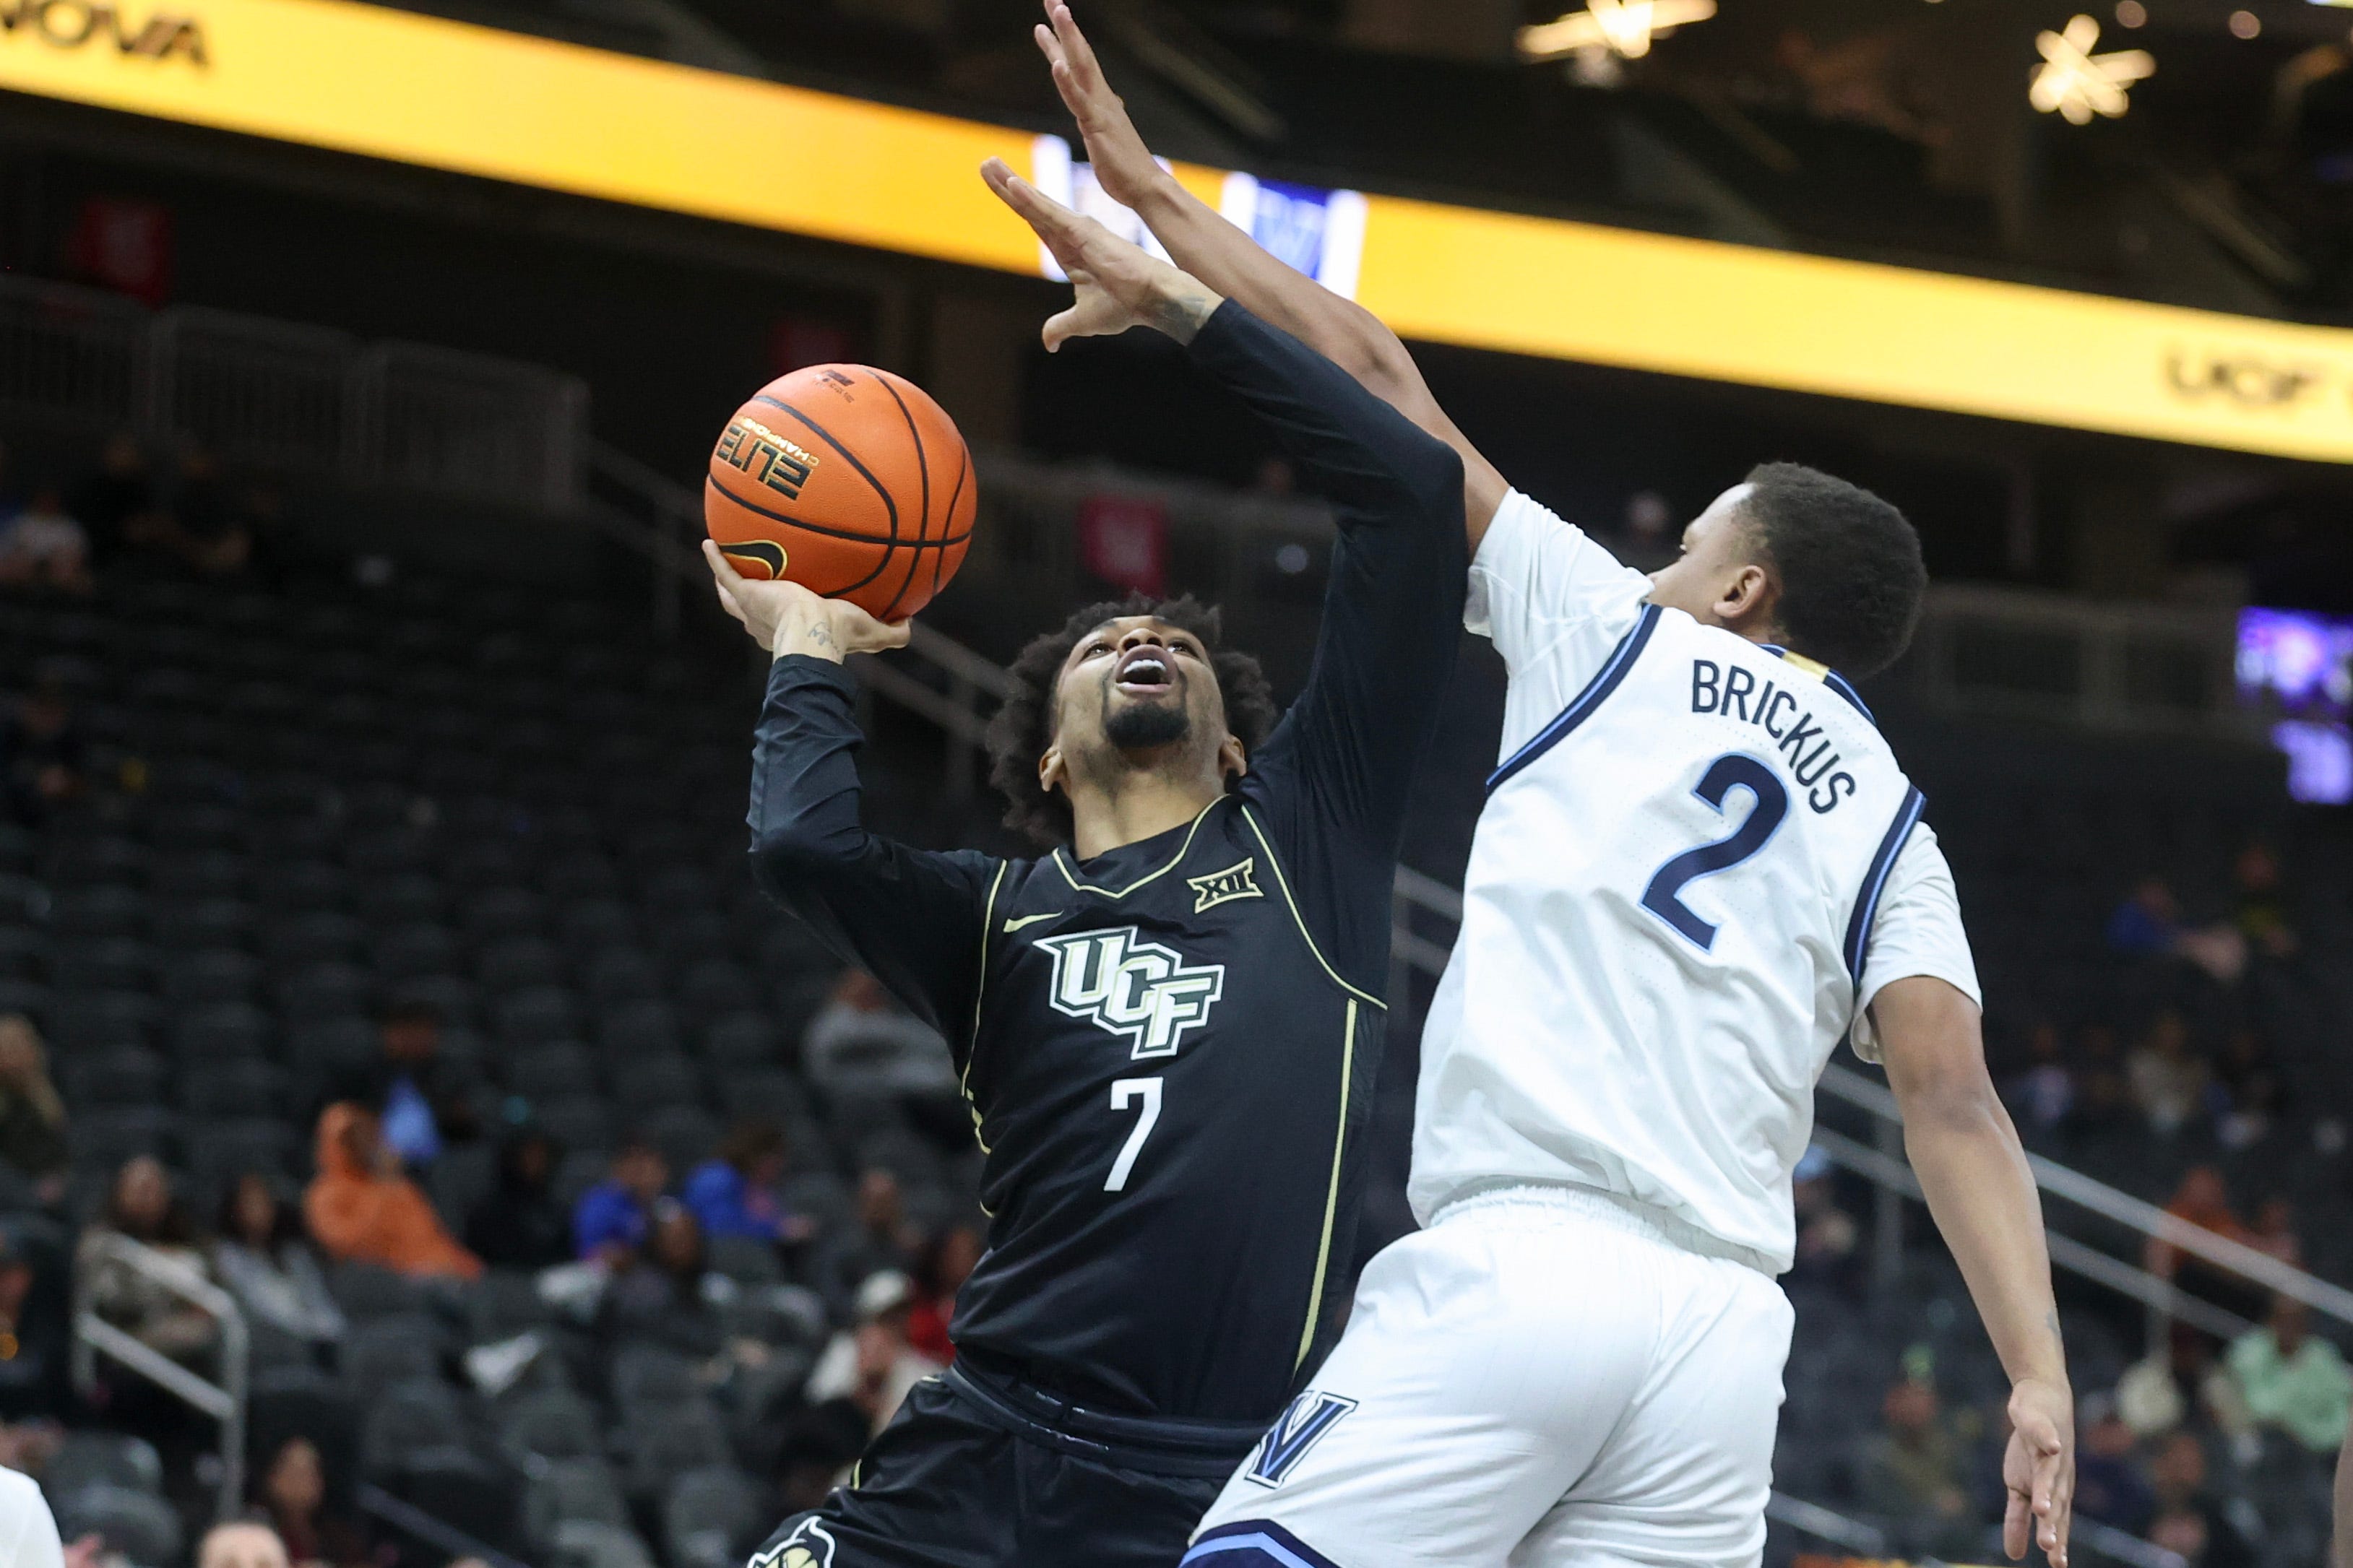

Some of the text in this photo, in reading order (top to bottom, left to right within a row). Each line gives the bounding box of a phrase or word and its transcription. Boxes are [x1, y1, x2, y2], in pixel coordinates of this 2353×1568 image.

[716, 425, 813, 501] ELITE
[1692, 659, 1857, 815] BRICKUS
[1187, 857, 1264, 914] XII
[1638, 750, 1792, 956] 2
[1032, 925, 1226, 1061] UCF
[1103, 1075, 1164, 1192] 7
[1243, 1390, 1359, 1490] V
